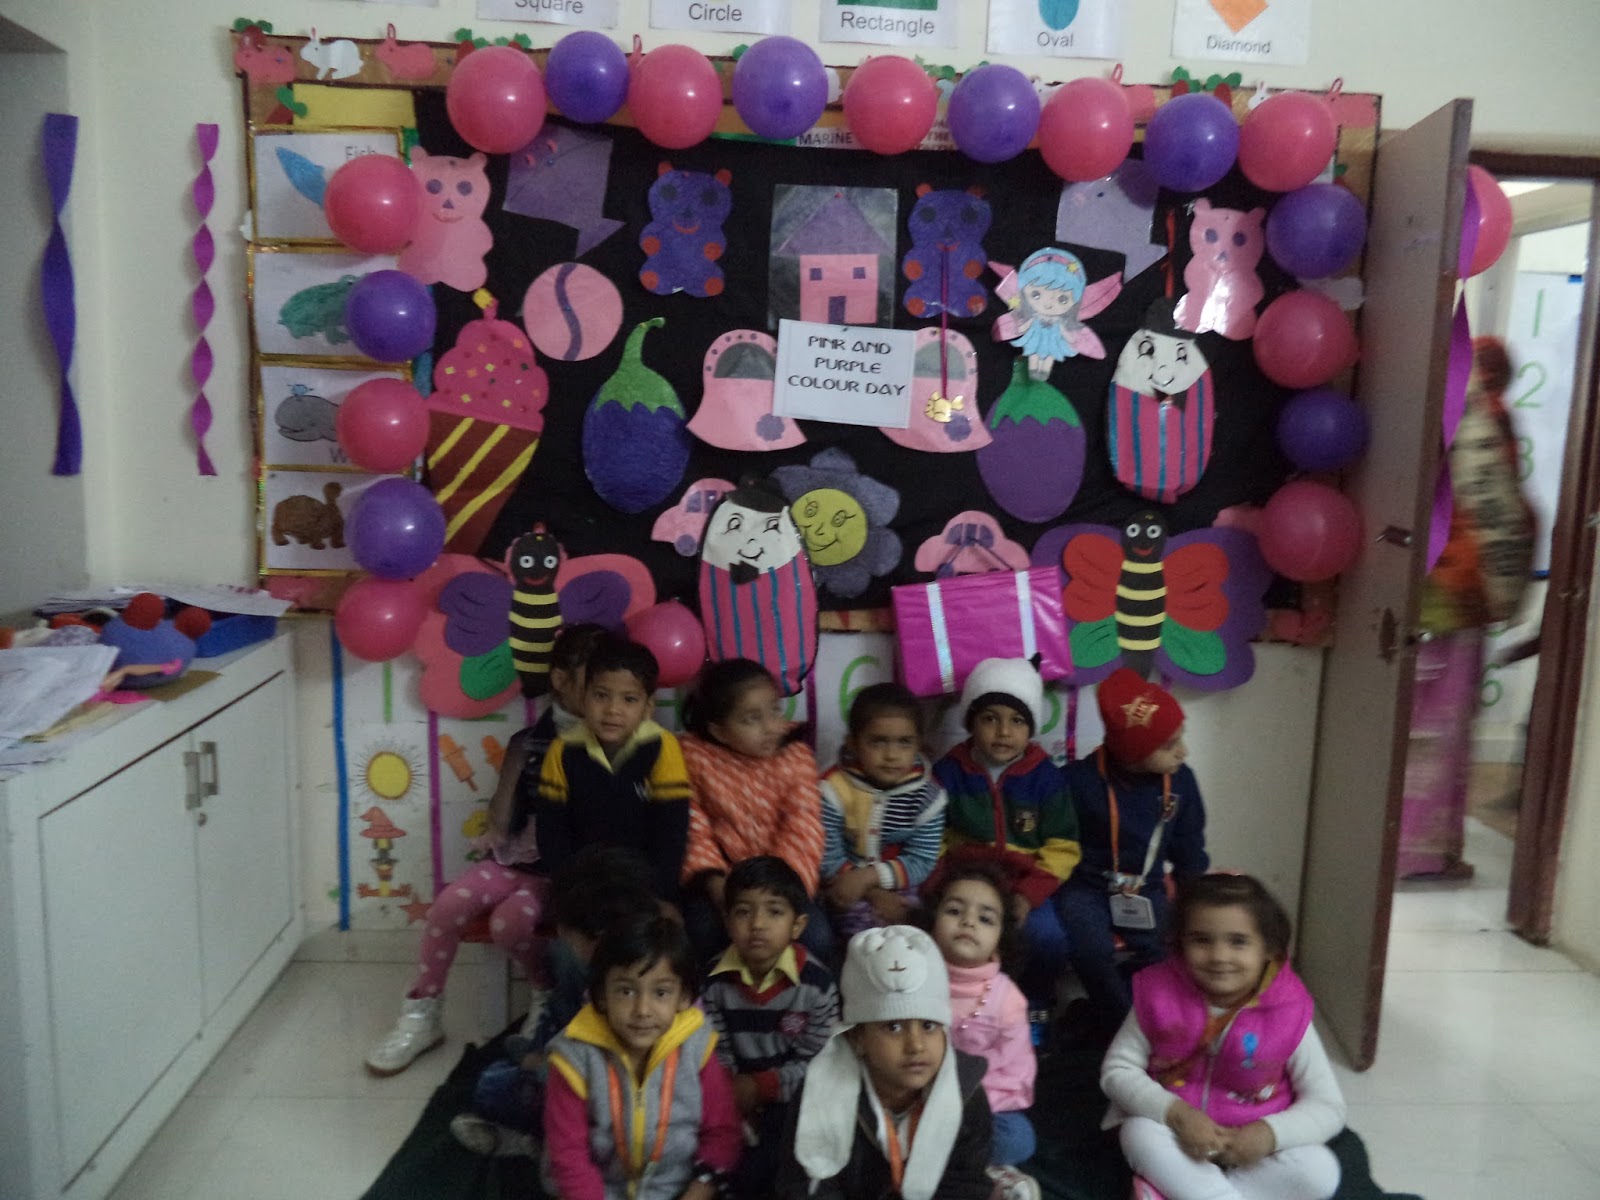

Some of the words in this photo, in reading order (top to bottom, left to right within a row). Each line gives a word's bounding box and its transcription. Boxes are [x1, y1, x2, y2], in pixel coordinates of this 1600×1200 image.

[688, 3, 742, 22] Circle
[840, 11, 935, 37] Rectangle
[1036, 31, 1074, 48] Oval
[1206, 35, 1272, 55] Diamond
[799, 132, 853, 145] MARINE
[808, 335, 846, 350] PINK
[852, 340, 892, 355] AND
[814, 357, 882, 374] PURPLE
[788, 375, 860, 393] COLOUR
[865, 382, 906, 396] DAY
[1513, 360, 1548, 409] 2
